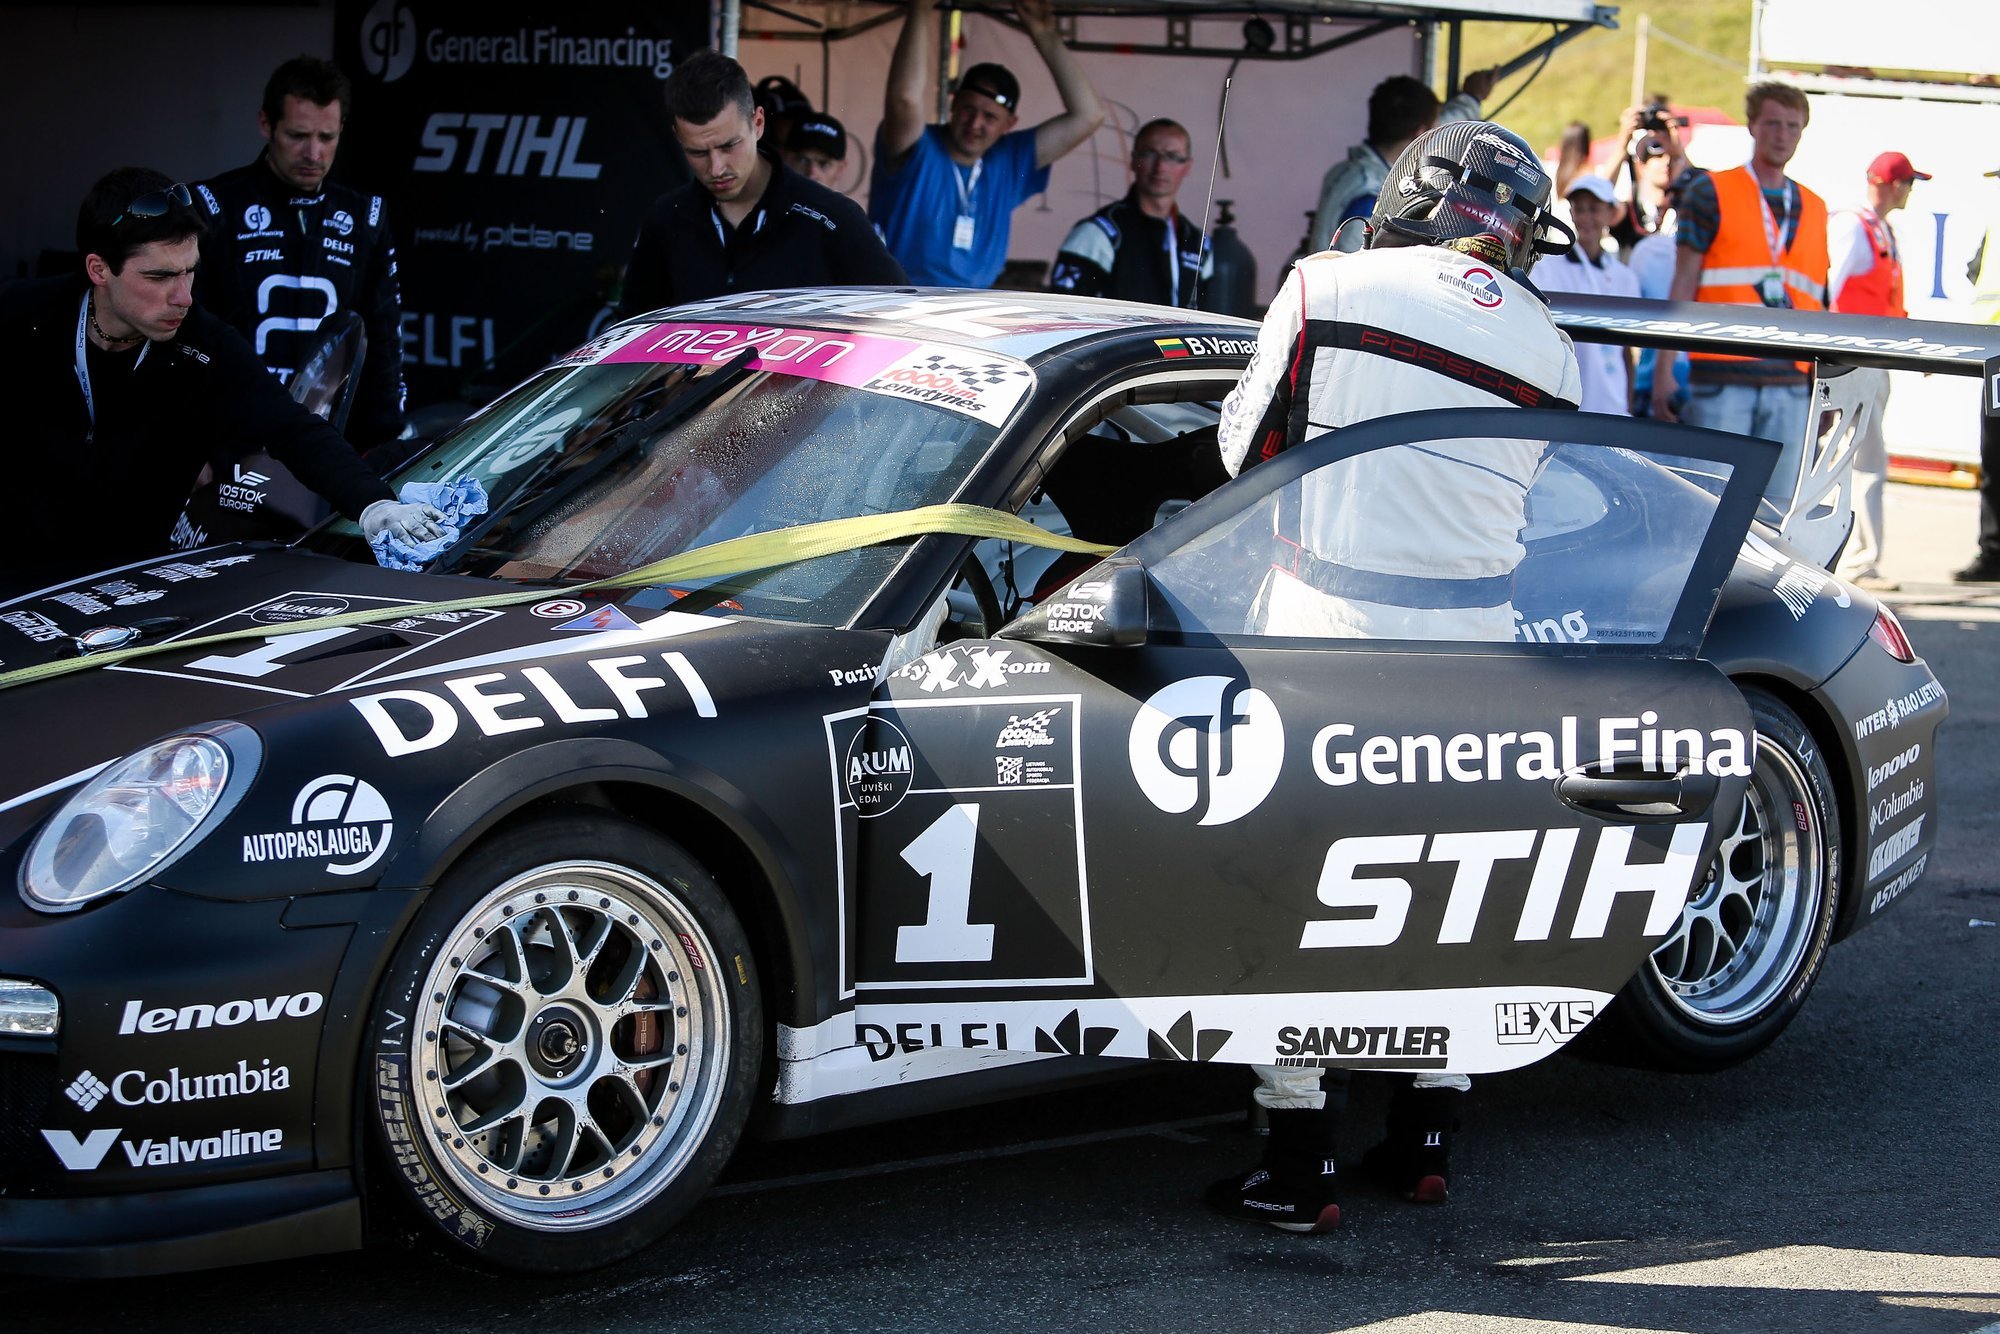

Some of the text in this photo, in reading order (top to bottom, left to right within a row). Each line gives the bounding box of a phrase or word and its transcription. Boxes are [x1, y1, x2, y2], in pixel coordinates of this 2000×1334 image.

[426, 25, 674, 80] General Financing
[412, 111, 603, 180] STIHL
[243, 248, 285, 263] STIHL
[322, 236, 355, 254] DELFI
[484, 222, 595, 252] pitlane
[1438, 272, 1494, 303] AUTOPASLAUGA
[398, 311, 496, 371] ELFI
[646, 326, 856, 369] mexon
[1551, 310, 1986, 357] eneral Financing
[1360, 331, 1542, 408] PORSCHE
[219, 483, 267, 505] VOSTOK
[219, 497, 254, 513] EUROPE
[1046, 603, 1107, 621] VOSTOK
[1047, 619, 1094, 634] EUROPE
[349, 650, 721, 758] DELFI
[1856, 680, 1946, 741] INTER RAO LIETUV
[1311, 715, 1578, 786] General
[1867, 743, 1921, 794] lenovo
[1878, 779, 1924, 826] Columbia
[243, 825, 375, 863] AUTOPASLAUGA
[895, 803, 995, 963] 1
[1300, 823, 1708, 950] STIH
[1881, 853, 1928, 909] STOKKER
[679, 933, 705, 969] BBS
[118, 990, 324, 1035] lenovo
[1495, 1001, 1597, 1046] HEXIS
[1275, 1025, 1450, 1057] SANDTLER
[111, 1057, 291, 1107] Columbia
[121, 1127, 283, 1168] Valvoline
[379, 1055, 459, 1222] MICHELIN
[1243, 1199, 1296, 1212] PORSCHE
